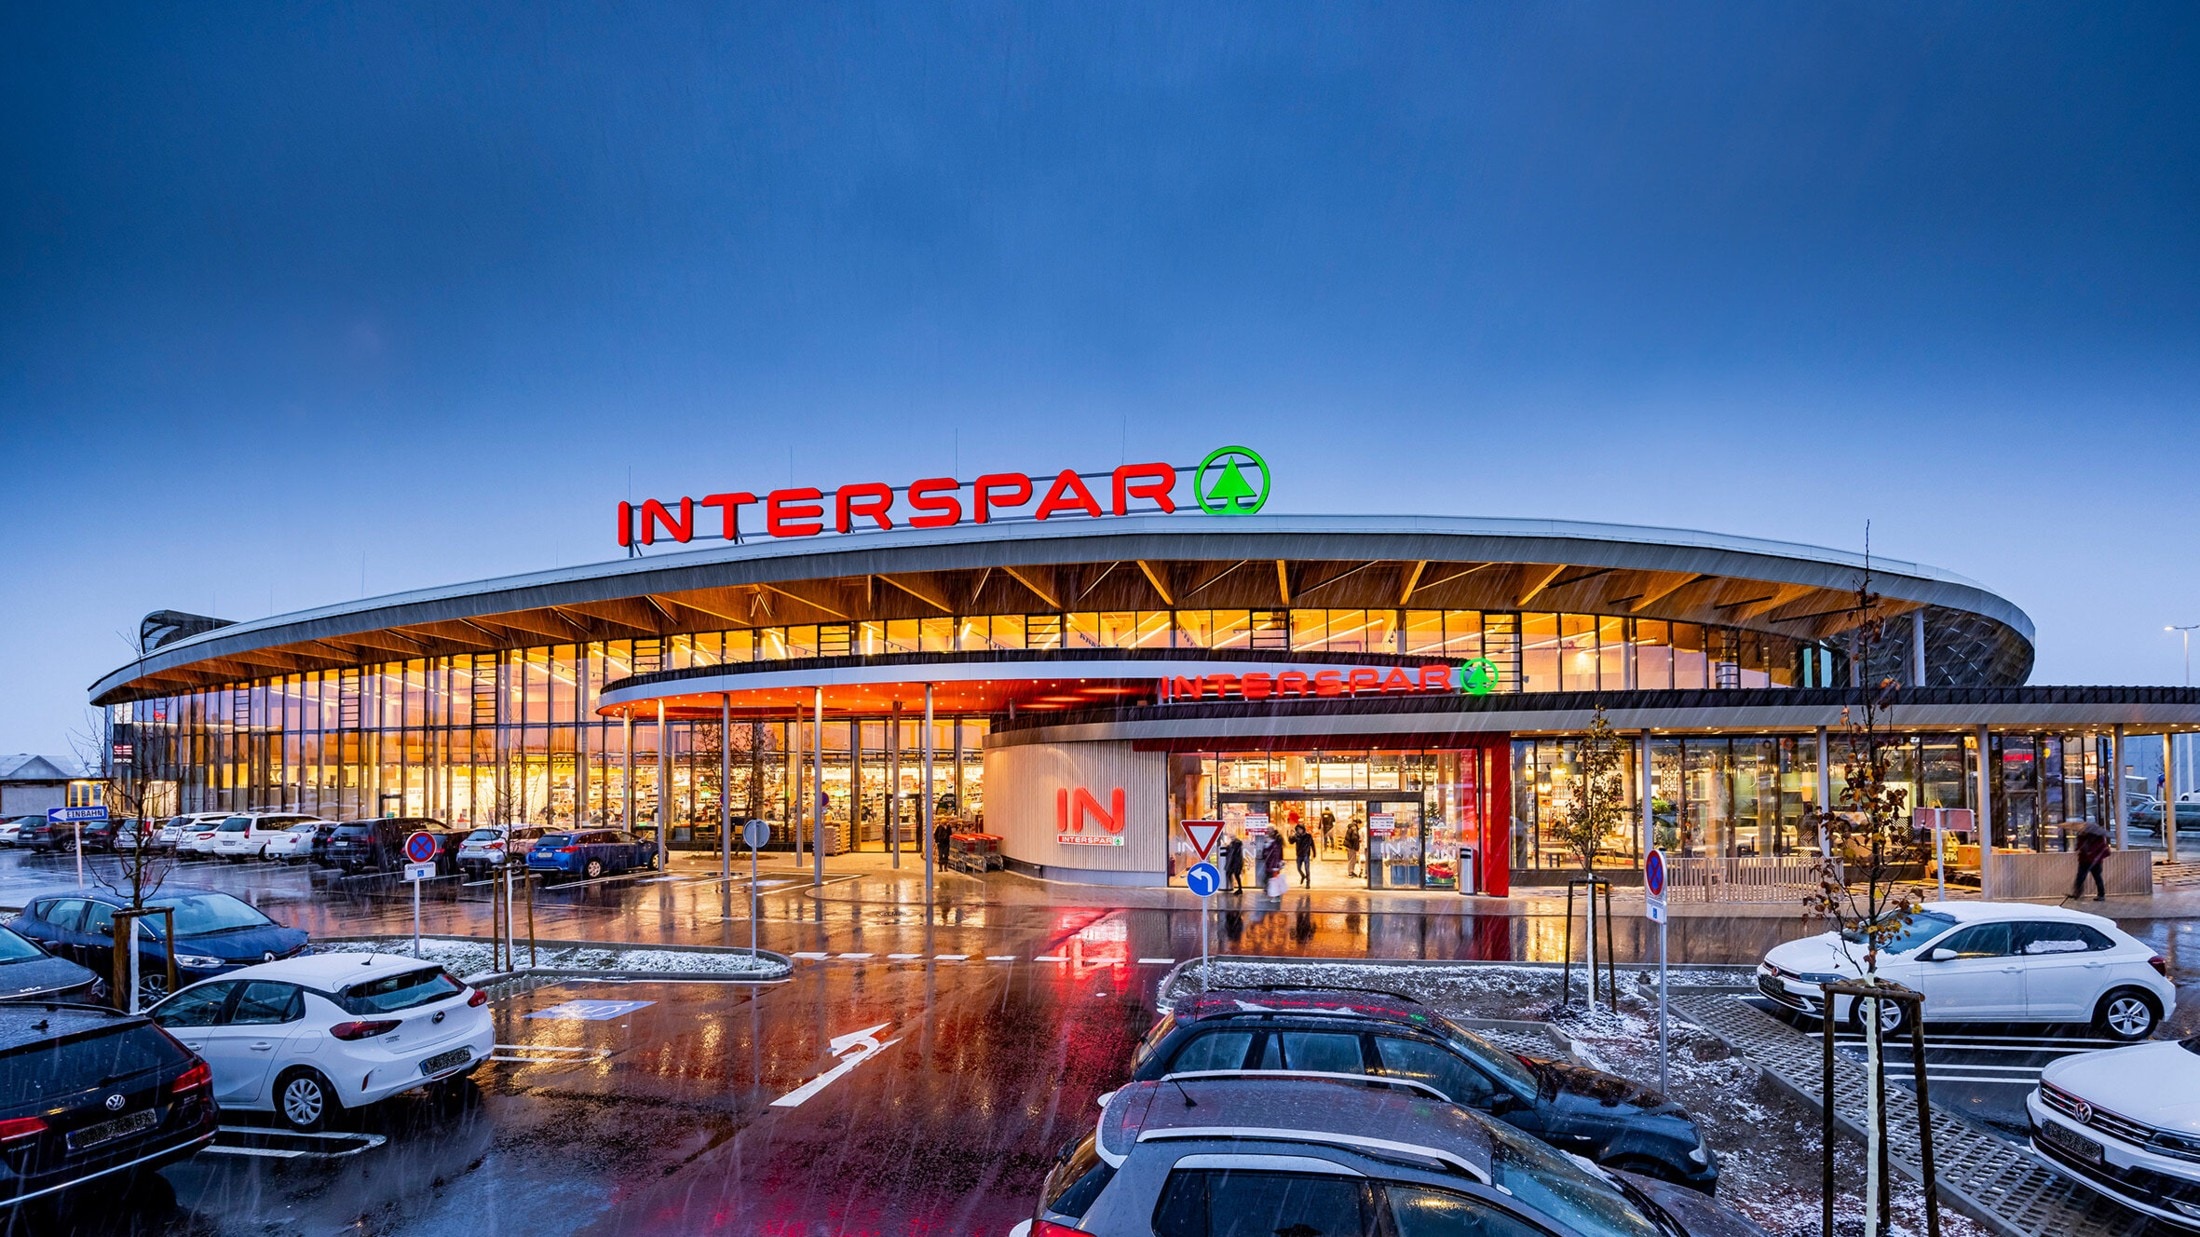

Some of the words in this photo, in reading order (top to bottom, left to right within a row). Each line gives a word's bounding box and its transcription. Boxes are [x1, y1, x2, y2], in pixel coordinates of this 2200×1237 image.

[618, 462, 1176, 547] INTERSPAR
[1161, 665, 1451, 699] INTERSPAR
[66, 809, 104, 818] EINBAHN
[1056, 786, 1125, 834] IN
[1061, 836, 1112, 845] INTERSPAR
